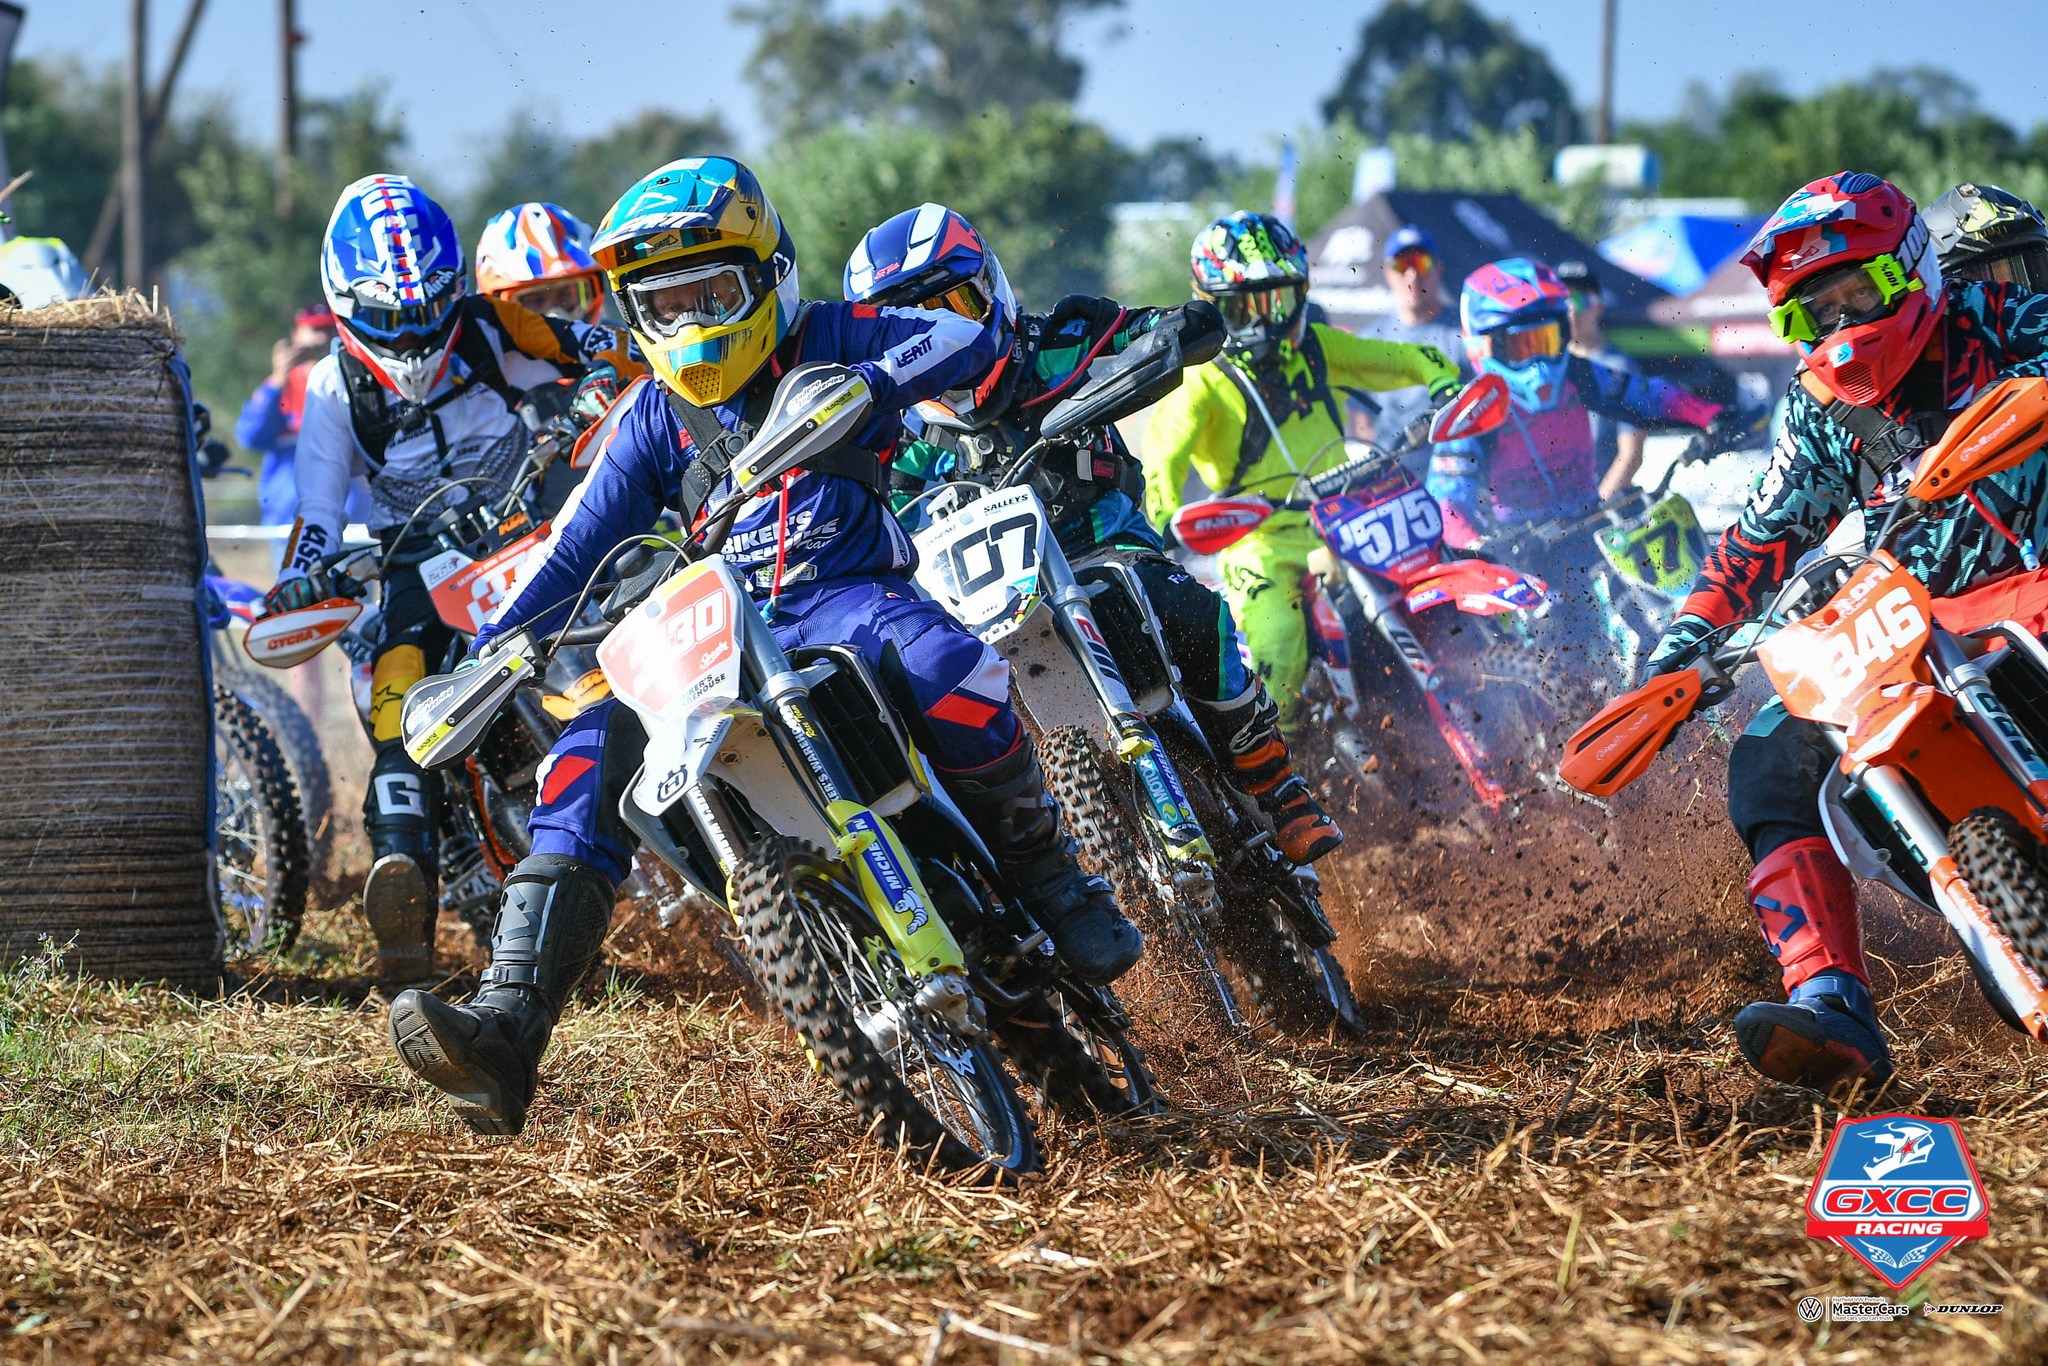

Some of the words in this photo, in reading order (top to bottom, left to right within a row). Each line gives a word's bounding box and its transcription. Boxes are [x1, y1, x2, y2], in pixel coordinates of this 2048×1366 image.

[424, 270, 454, 298] Airoh
[983, 494, 1029, 514] SALLEYS
[817, 772, 842, 802] KER'S
[852, 818, 903, 890] MICHEN
